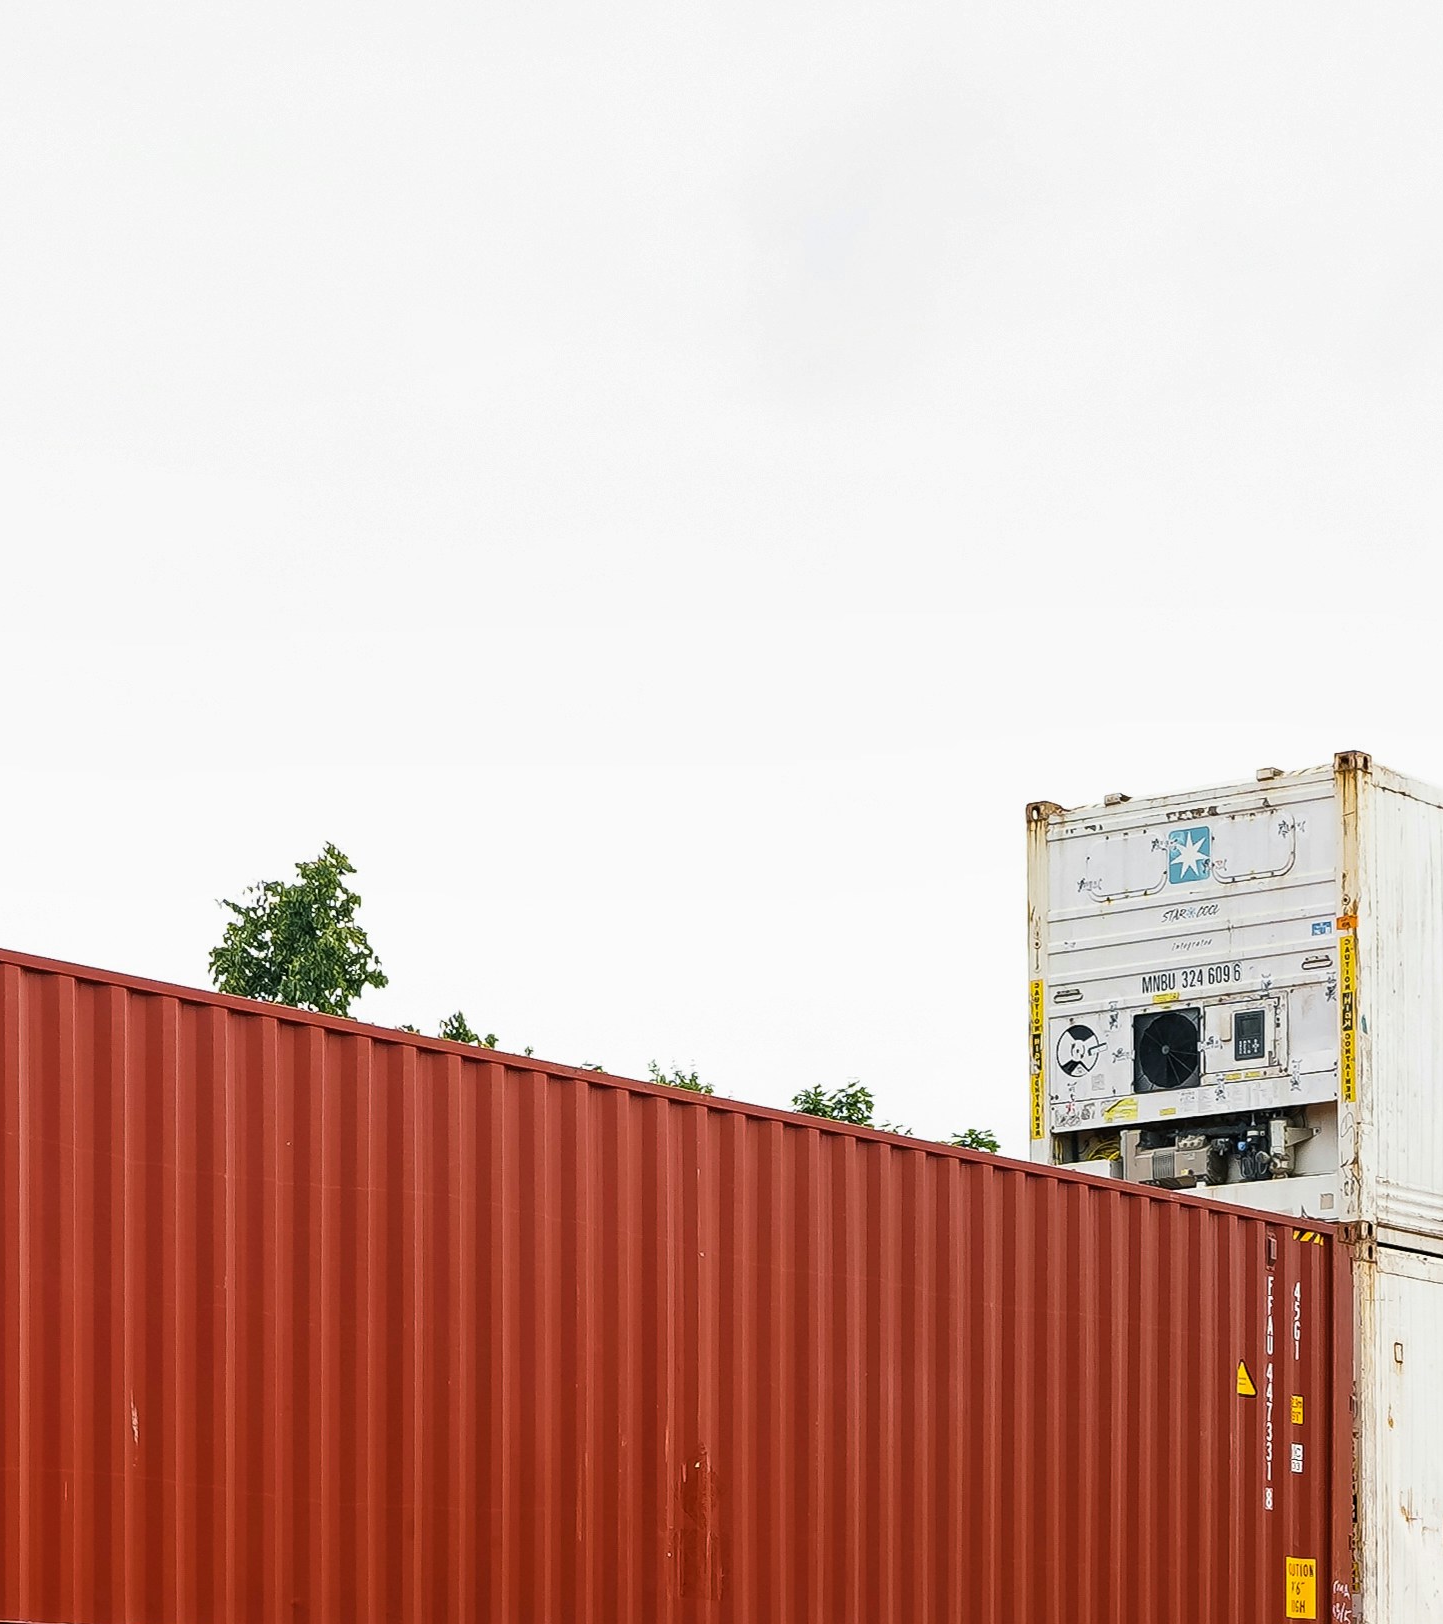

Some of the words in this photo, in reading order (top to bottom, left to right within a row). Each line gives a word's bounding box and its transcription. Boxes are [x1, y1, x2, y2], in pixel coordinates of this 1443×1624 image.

[1142, 972, 1176, 994] MNBU
[1181, 968, 1203, 988] 324
[1208, 964, 1230, 985] 609
[1233, 963, 1241, 981] 6
[1344, 1033, 1352, 1101] CONTAINER
[1265, 1276, 1274, 1355] FFAU
[1293, 1282, 1301, 1360] 45G1
